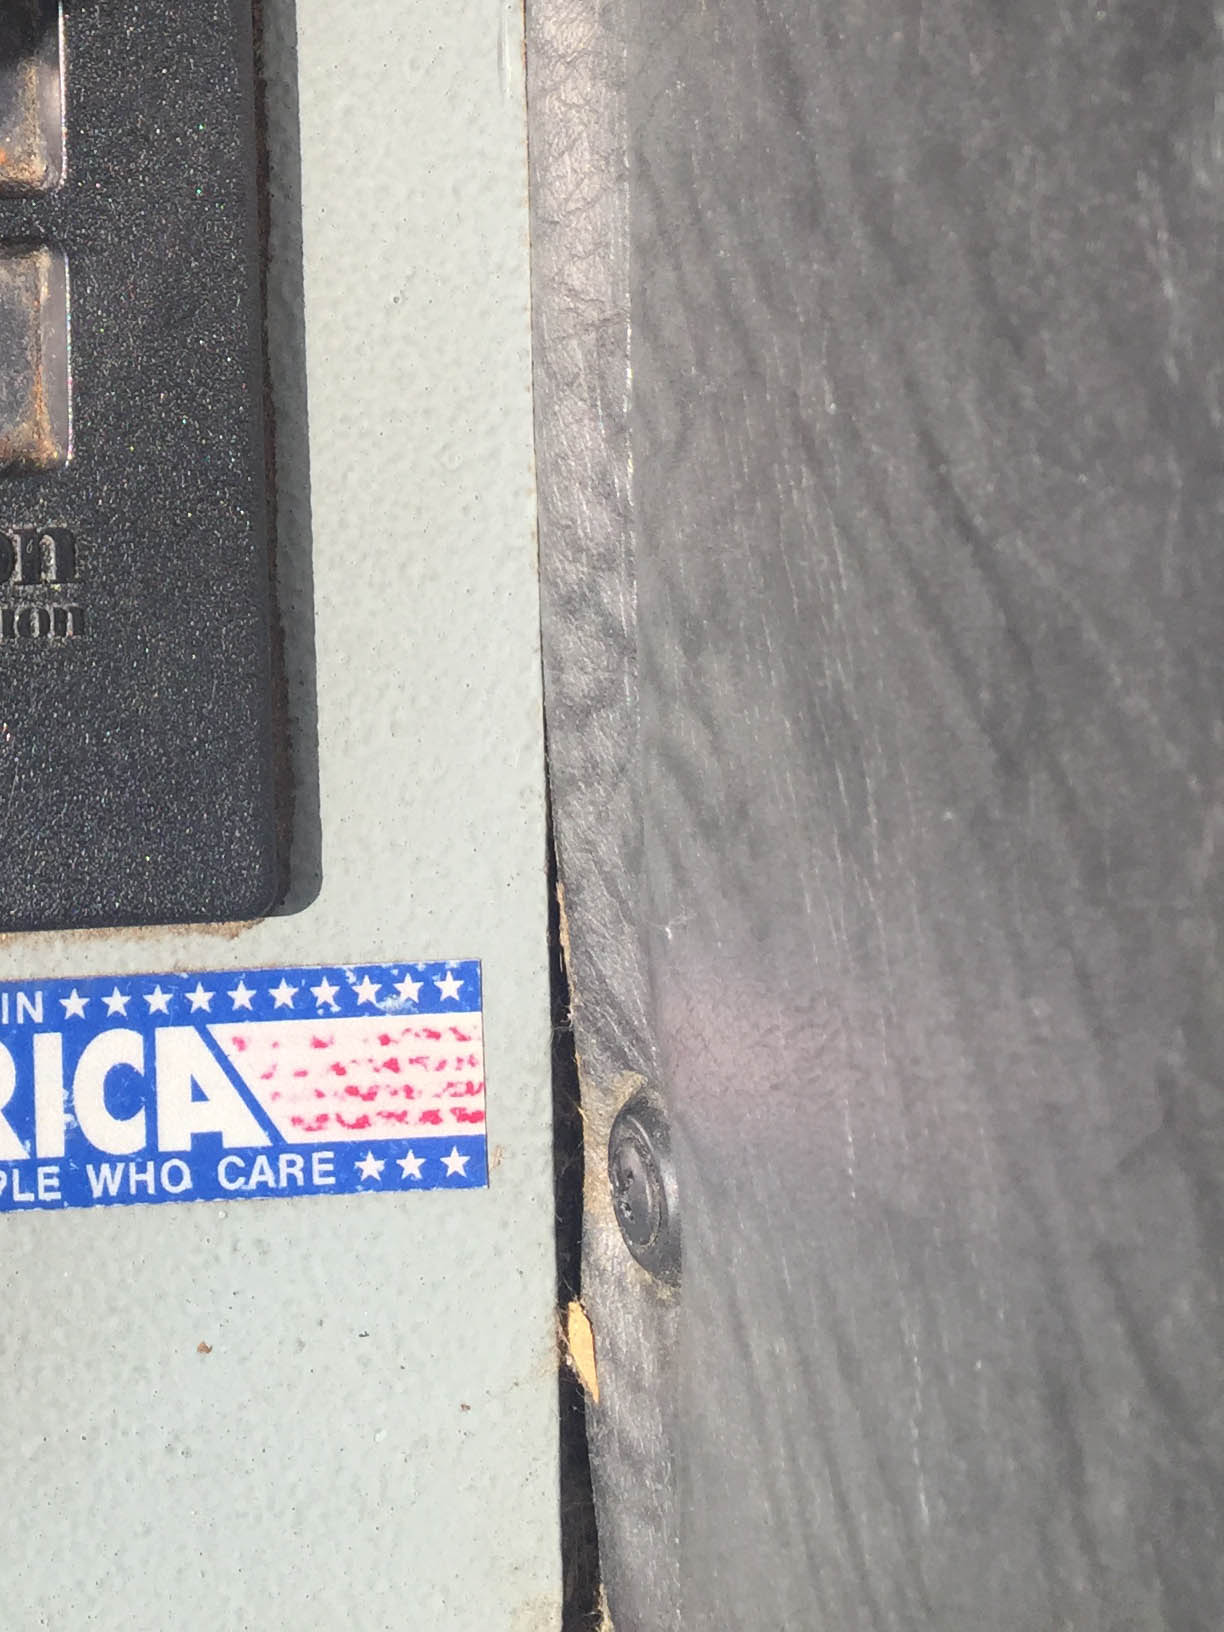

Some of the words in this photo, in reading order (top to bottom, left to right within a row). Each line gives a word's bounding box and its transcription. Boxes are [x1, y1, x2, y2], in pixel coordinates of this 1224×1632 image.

[1, 990, 44, 1025] IN
[86, 1158, 194, 1198] WHO
[217, 1151, 336, 1189] CARE
